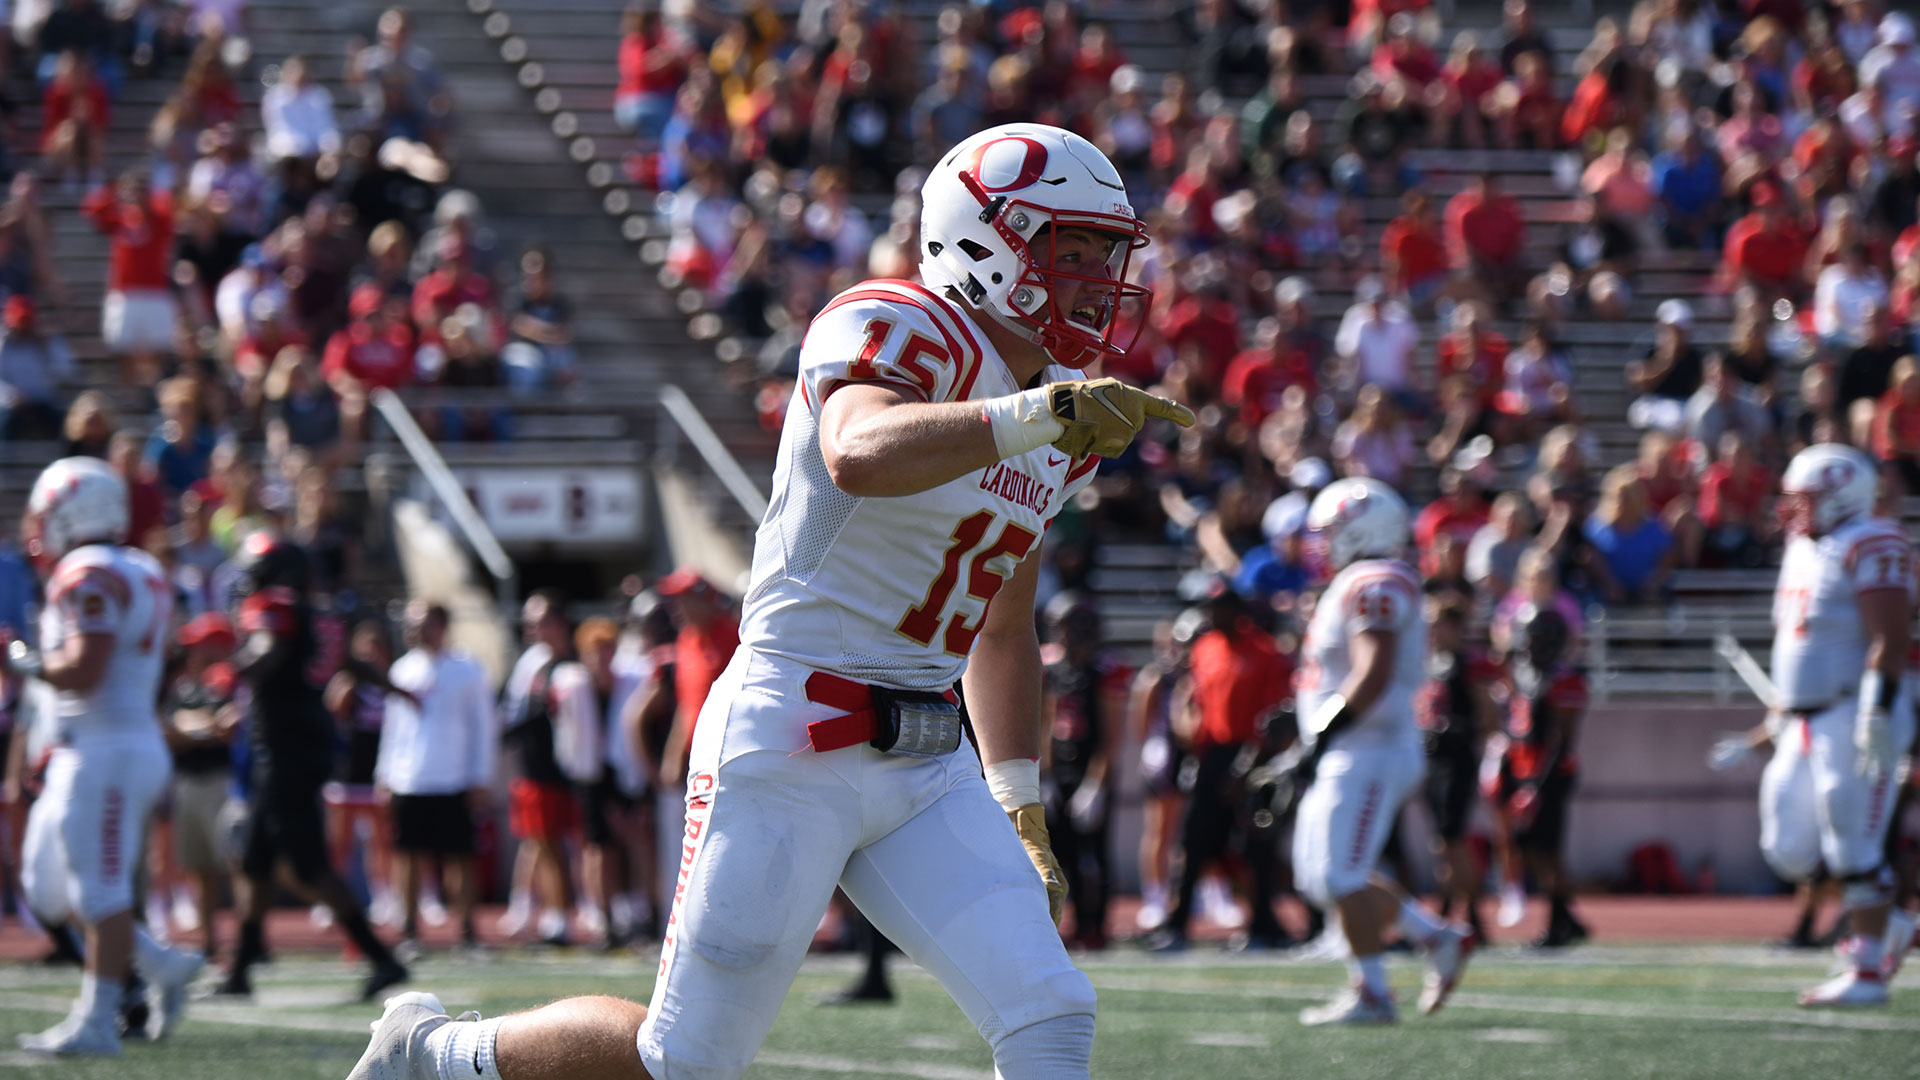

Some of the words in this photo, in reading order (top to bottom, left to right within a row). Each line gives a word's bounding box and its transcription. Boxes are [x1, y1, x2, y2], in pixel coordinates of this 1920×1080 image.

[847, 316, 951, 395] 15
[980, 463, 1054, 516] CARDINALS
[894, 508, 1038, 659] 15
